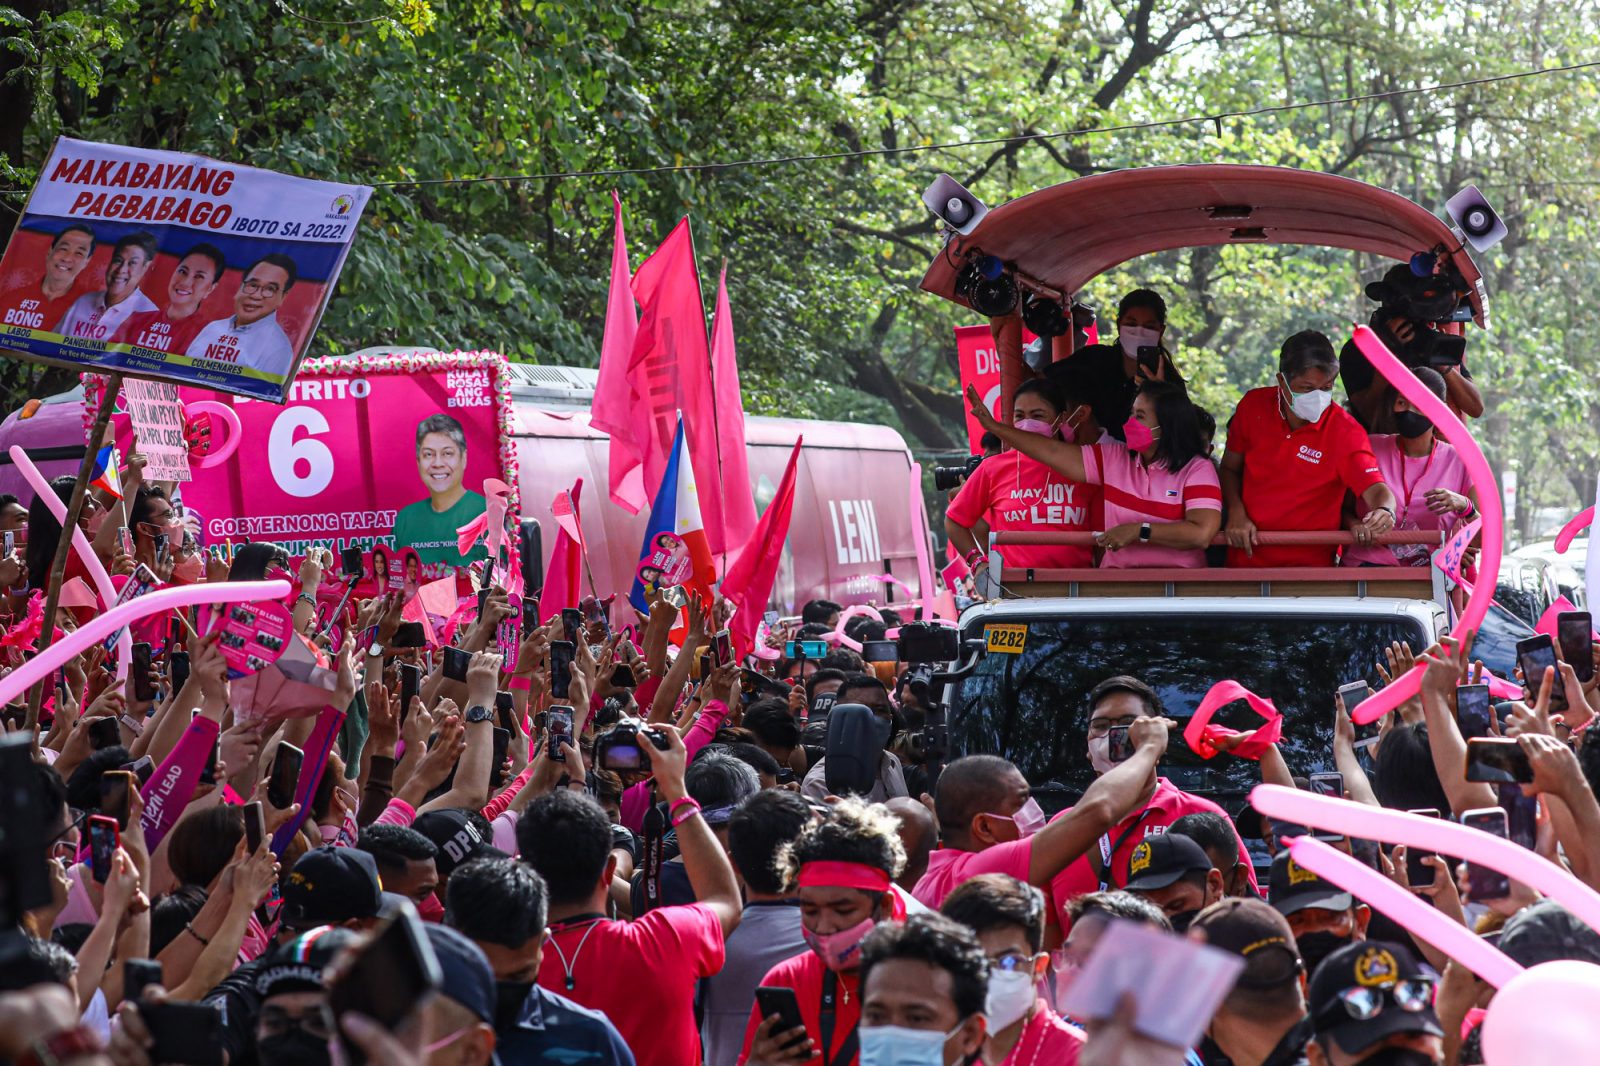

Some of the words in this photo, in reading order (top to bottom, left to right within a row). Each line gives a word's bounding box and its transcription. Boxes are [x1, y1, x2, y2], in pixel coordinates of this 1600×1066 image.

[50, 158, 235, 196] MAKABAYANG
[69, 191, 232, 229] PAGBABAGO
[231, 217, 279, 235] IBOTO
[280, 221, 301, 237] SA
[302, 223, 347, 239] 2022!
[20, 299, 40, 311] #37
[4, 308, 44, 328] BONG
[7, 326, 32, 338] LABOG
[73, 320, 107, 339] KIKO
[150, 321, 171, 334] #10
[62, 336, 108, 351] PANGILINAN
[137, 330, 172, 351] LENI
[218, 334, 239, 346] #16
[130, 346, 167, 361] ROBREDO
[204, 343, 240, 363] NERI
[136, 360, 161, 371] President
[191, 358, 243, 375] COLMENARES
[447, 377, 490, 388] ROSAS
[447, 396, 491, 407] BUKAS
[455, 387, 482, 398] ANG
[268, 405, 335, 498] 6
[1011, 488, 1042, 499] MAY
[1042, 483, 1075, 504] JOY
[209, 513, 340, 537] GOBYERNONG
[341, 510, 397, 530] TAPAT
[1004, 509, 1028, 522] KAY
[1031, 506, 1086, 525] LENI
[828, 499, 881, 564] LENI
[411, 540, 440, 548] FRANCIS
[991, 630, 1025, 648] 8282
[158, 765, 182, 796] LEAD
